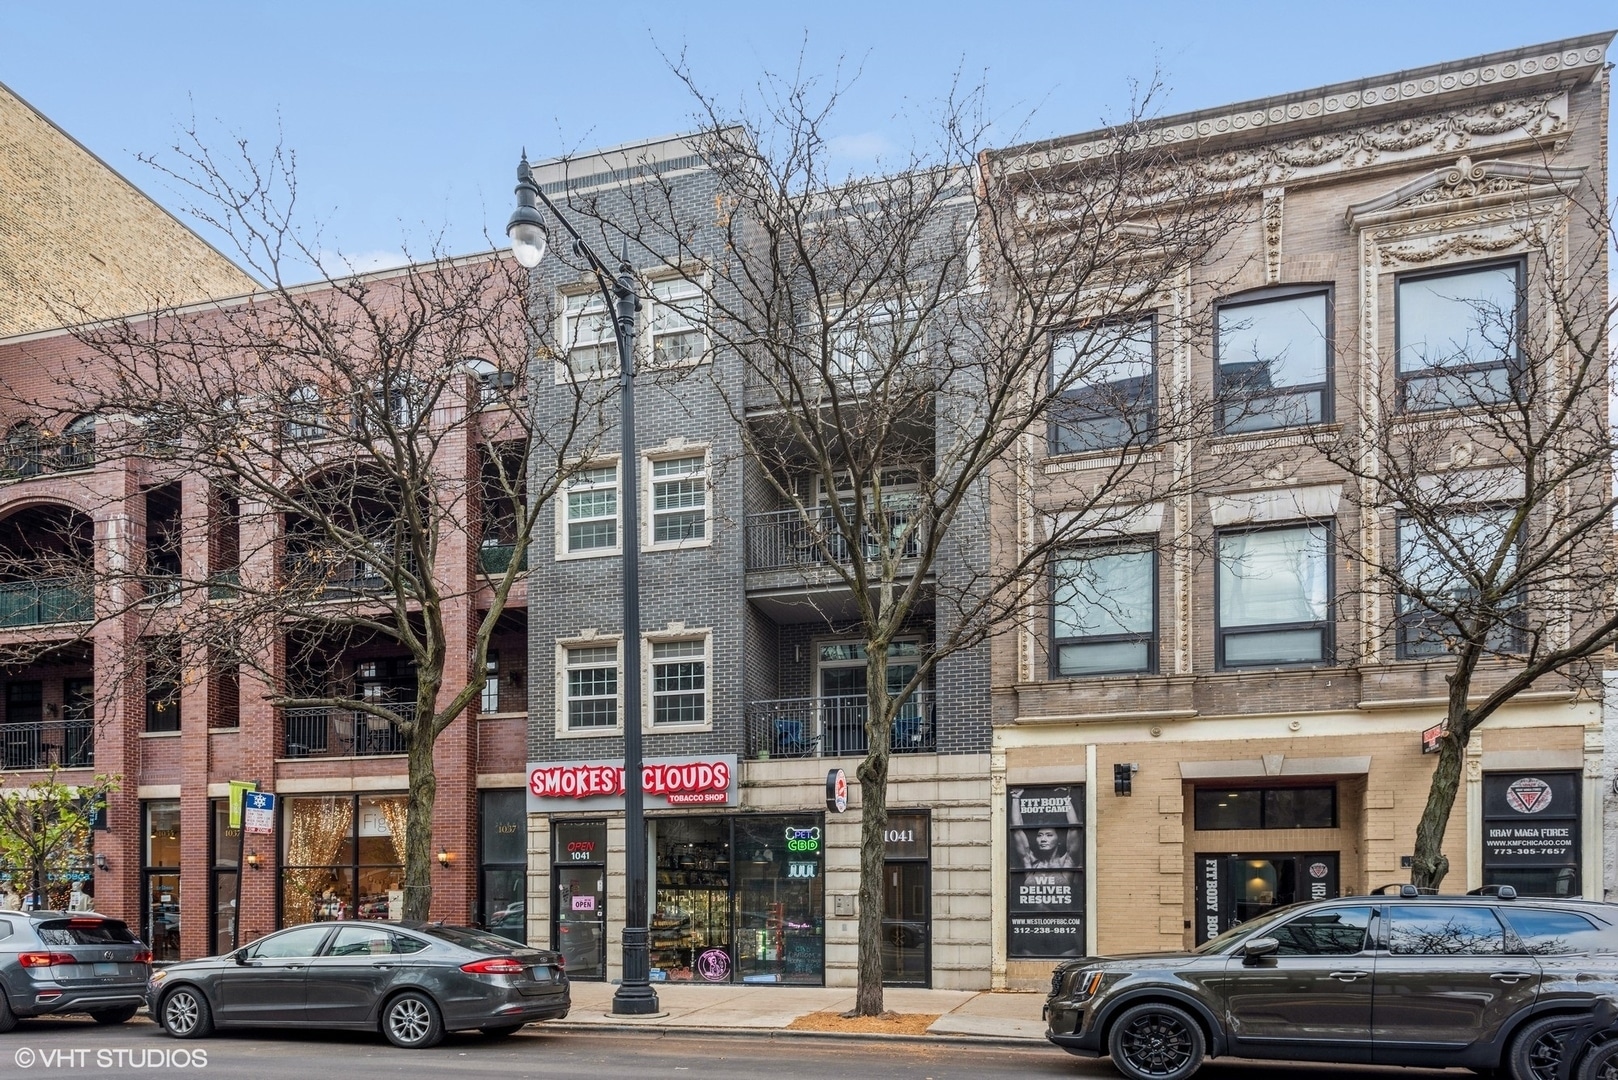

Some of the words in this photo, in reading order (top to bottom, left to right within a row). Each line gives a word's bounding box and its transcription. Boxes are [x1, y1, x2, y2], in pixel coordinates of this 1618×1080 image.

[531, 766, 616, 797] SMOKES
[642, 763, 730, 793] CLOUDS
[669, 794, 704, 802] TOBACCO
[1020, 798, 1040, 807] FIT
[1040, 797, 1072, 806] BODY
[1020, 806, 1045, 814] BOOT
[1045, 805, 1072, 813] CAMP
[363, 813, 387, 833] Fig
[794, 831, 812, 839] PET
[884, 829, 914, 842] 1041
[1489, 828, 1513, 838] KRAV
[1514, 828, 1540, 837] MAGA
[1541, 828, 1569, 838] FORCE
[567, 841, 595, 852] OPEN
[787, 839, 818, 851] CBD
[571, 851, 590, 860] 1041
[1206, 859, 1218, 880] FIT
[1035, 876, 1056, 885] WE
[1019, 886, 1072, 895] DELIVER
[1019, 895, 1072, 904] RESULTS
[1206, 880, 1218, 912] BODY
